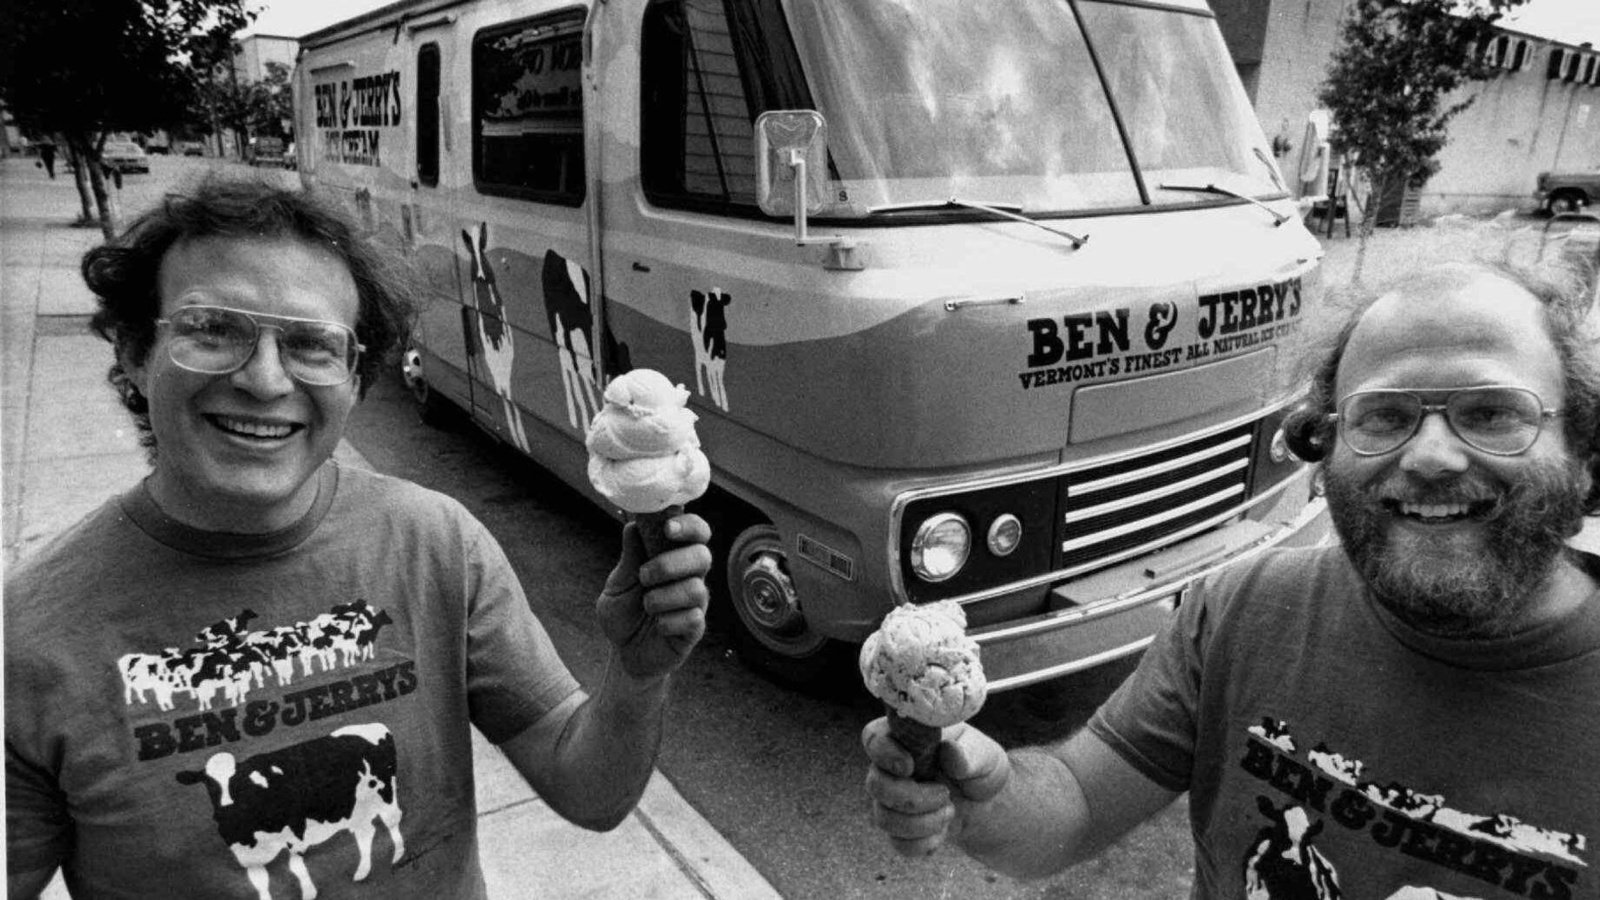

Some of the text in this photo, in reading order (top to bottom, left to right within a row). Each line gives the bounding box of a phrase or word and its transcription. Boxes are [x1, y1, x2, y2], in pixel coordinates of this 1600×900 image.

[315, 83, 337, 128] BEN
[342, 130, 381, 167] CREAM
[1027, 276, 1302, 367] BEN & JERRY'S
[1019, 357, 1120, 389] VERMONT'S
[1124, 348, 1182, 373] FINEST
[1186, 342, 1210, 358] ALL
[1213, 332, 1260, 355] NATURAL
[134, 708, 241, 761] BEN
[1241, 737, 1334, 813] BEN
